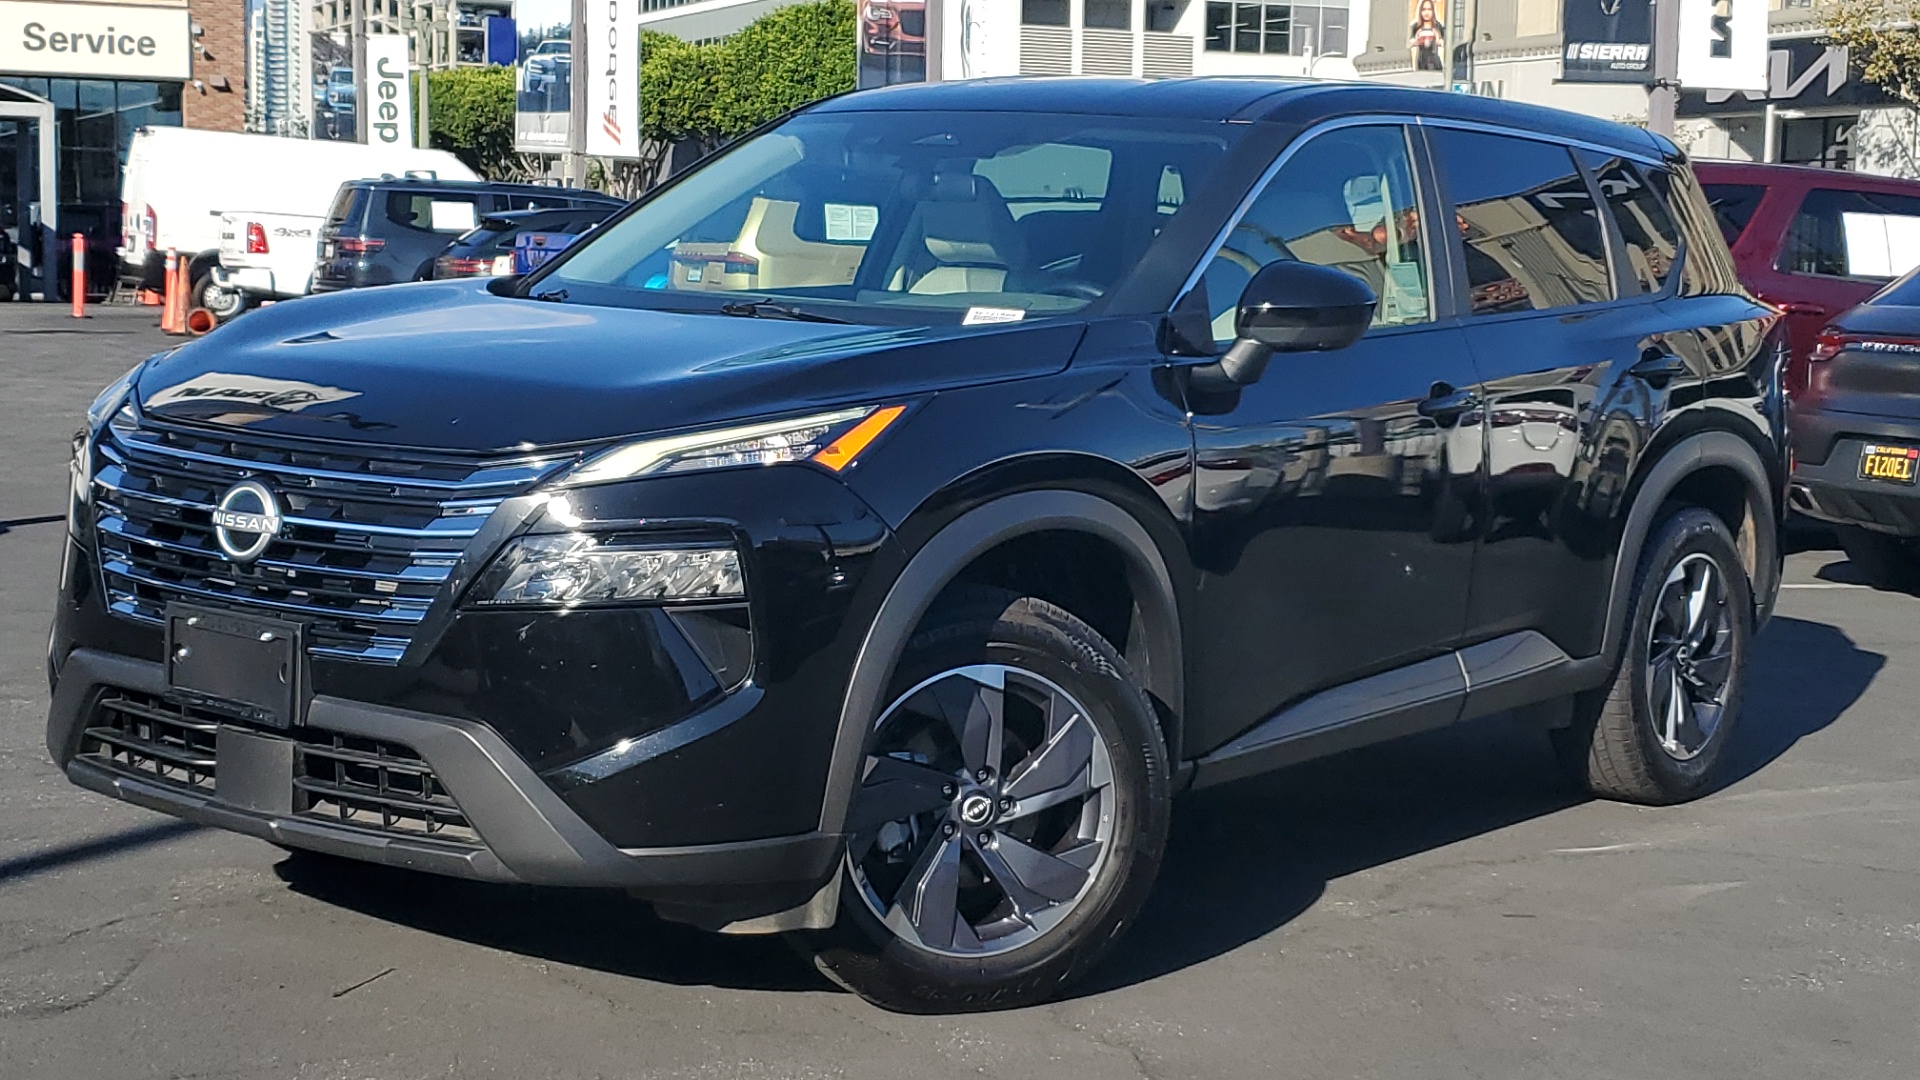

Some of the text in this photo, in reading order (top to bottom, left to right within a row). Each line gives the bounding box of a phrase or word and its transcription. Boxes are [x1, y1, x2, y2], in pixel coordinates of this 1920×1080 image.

[23, 22, 156, 56] Service
[1579, 43, 1651, 60] SIERRA
[605, 1, 617, 126] DODGE
[373, 57, 404, 143] Jeep
[212, 511, 277, 532] NISSAN
